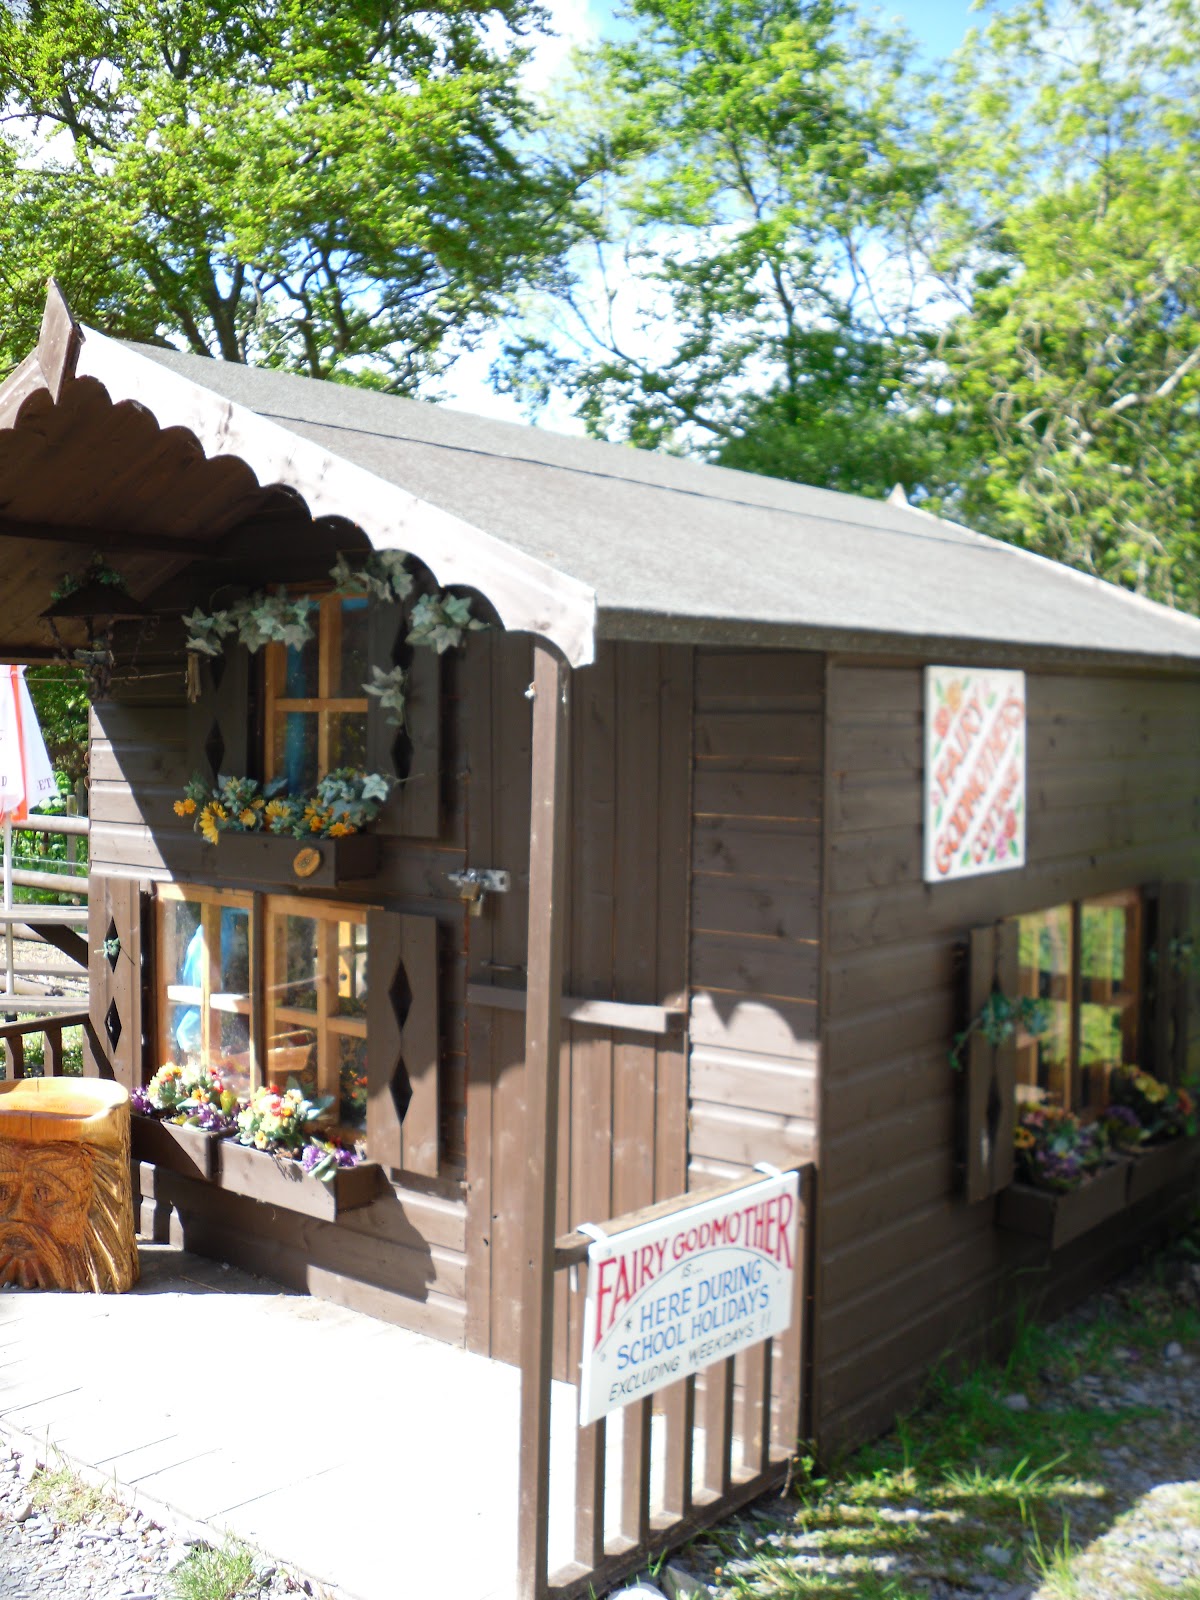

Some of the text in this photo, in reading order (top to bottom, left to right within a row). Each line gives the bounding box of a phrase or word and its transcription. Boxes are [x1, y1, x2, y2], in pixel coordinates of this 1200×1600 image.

[593, 1193, 794, 1351] FAIRY GODMOTHER
[640, 1259, 762, 1333] HERE DURING
[608, 1356, 681, 1402] EXCLUDING
[689, 1322, 754, 1363] WEEKDAYS
[617, 1284, 769, 1370] SCHOOL HOLIDAYS
